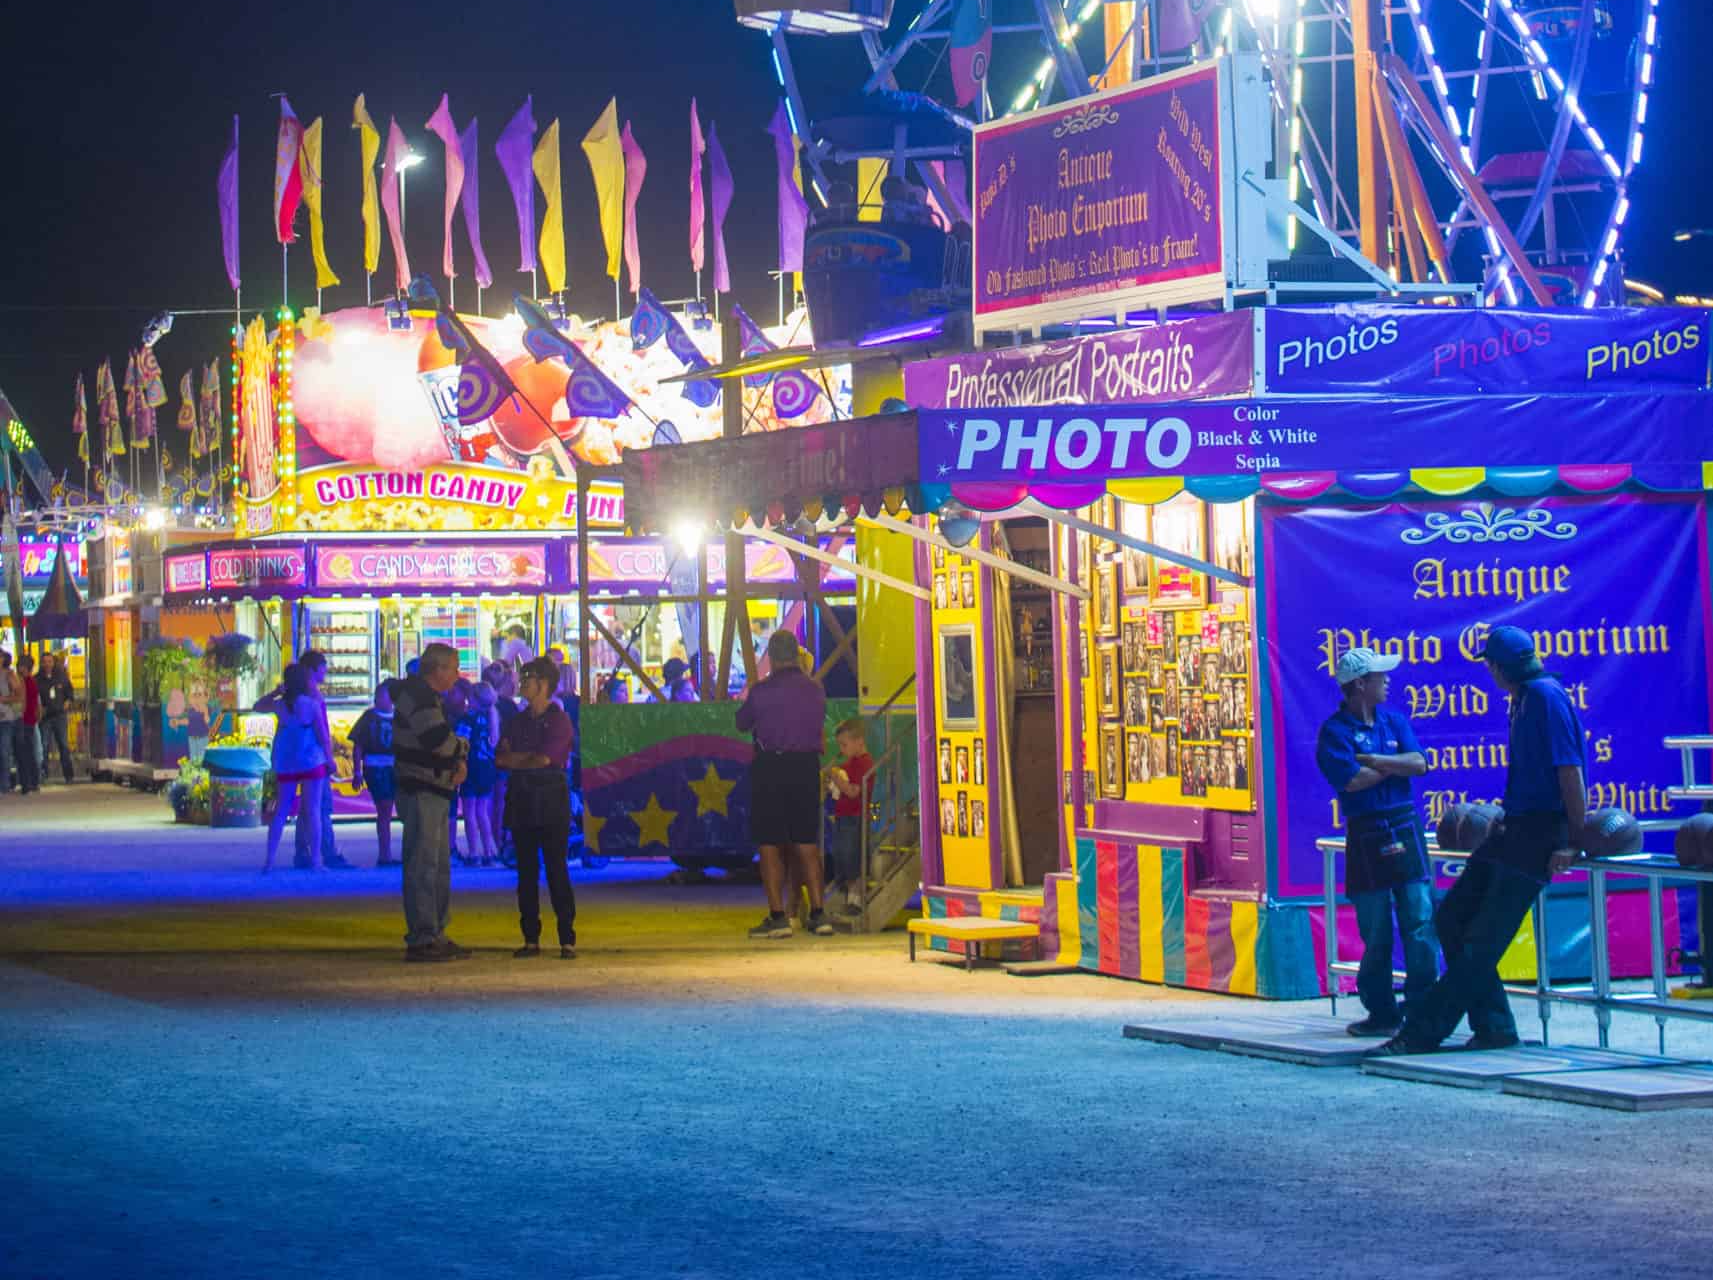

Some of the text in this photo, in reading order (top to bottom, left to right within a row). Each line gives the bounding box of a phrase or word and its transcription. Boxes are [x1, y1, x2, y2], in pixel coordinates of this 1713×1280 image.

[1057, 147, 1113, 191] Antique
[1027, 186, 1149, 254] Photo Emporium
[1150, 243, 1160, 266] to
[1090, 331, 1194, 404] Portraits
[1278, 318, 1399, 376] Photos
[1433, 320, 1552, 377] Photos
[1586, 324, 1700, 380] Photos
[1233, 405, 1280, 422] Color
[956, 417, 1192, 471] PHOTO
[1198, 428, 1318, 448] Black & White
[1236, 453, 1280, 473] Sepia
[316, 472, 423, 504] COTTON
[429, 473, 524, 508] CANDY
[213, 557, 242, 581] COLD
[244, 554, 295, 580] DRINKS
[360, 554, 429, 577] CANDY
[1413, 558, 1572, 603] Antique
[1459, 617, 1671, 664] Eporium
[1405, 683, 1489, 719] Wild
[1426, 733, 1508, 771] oarin
